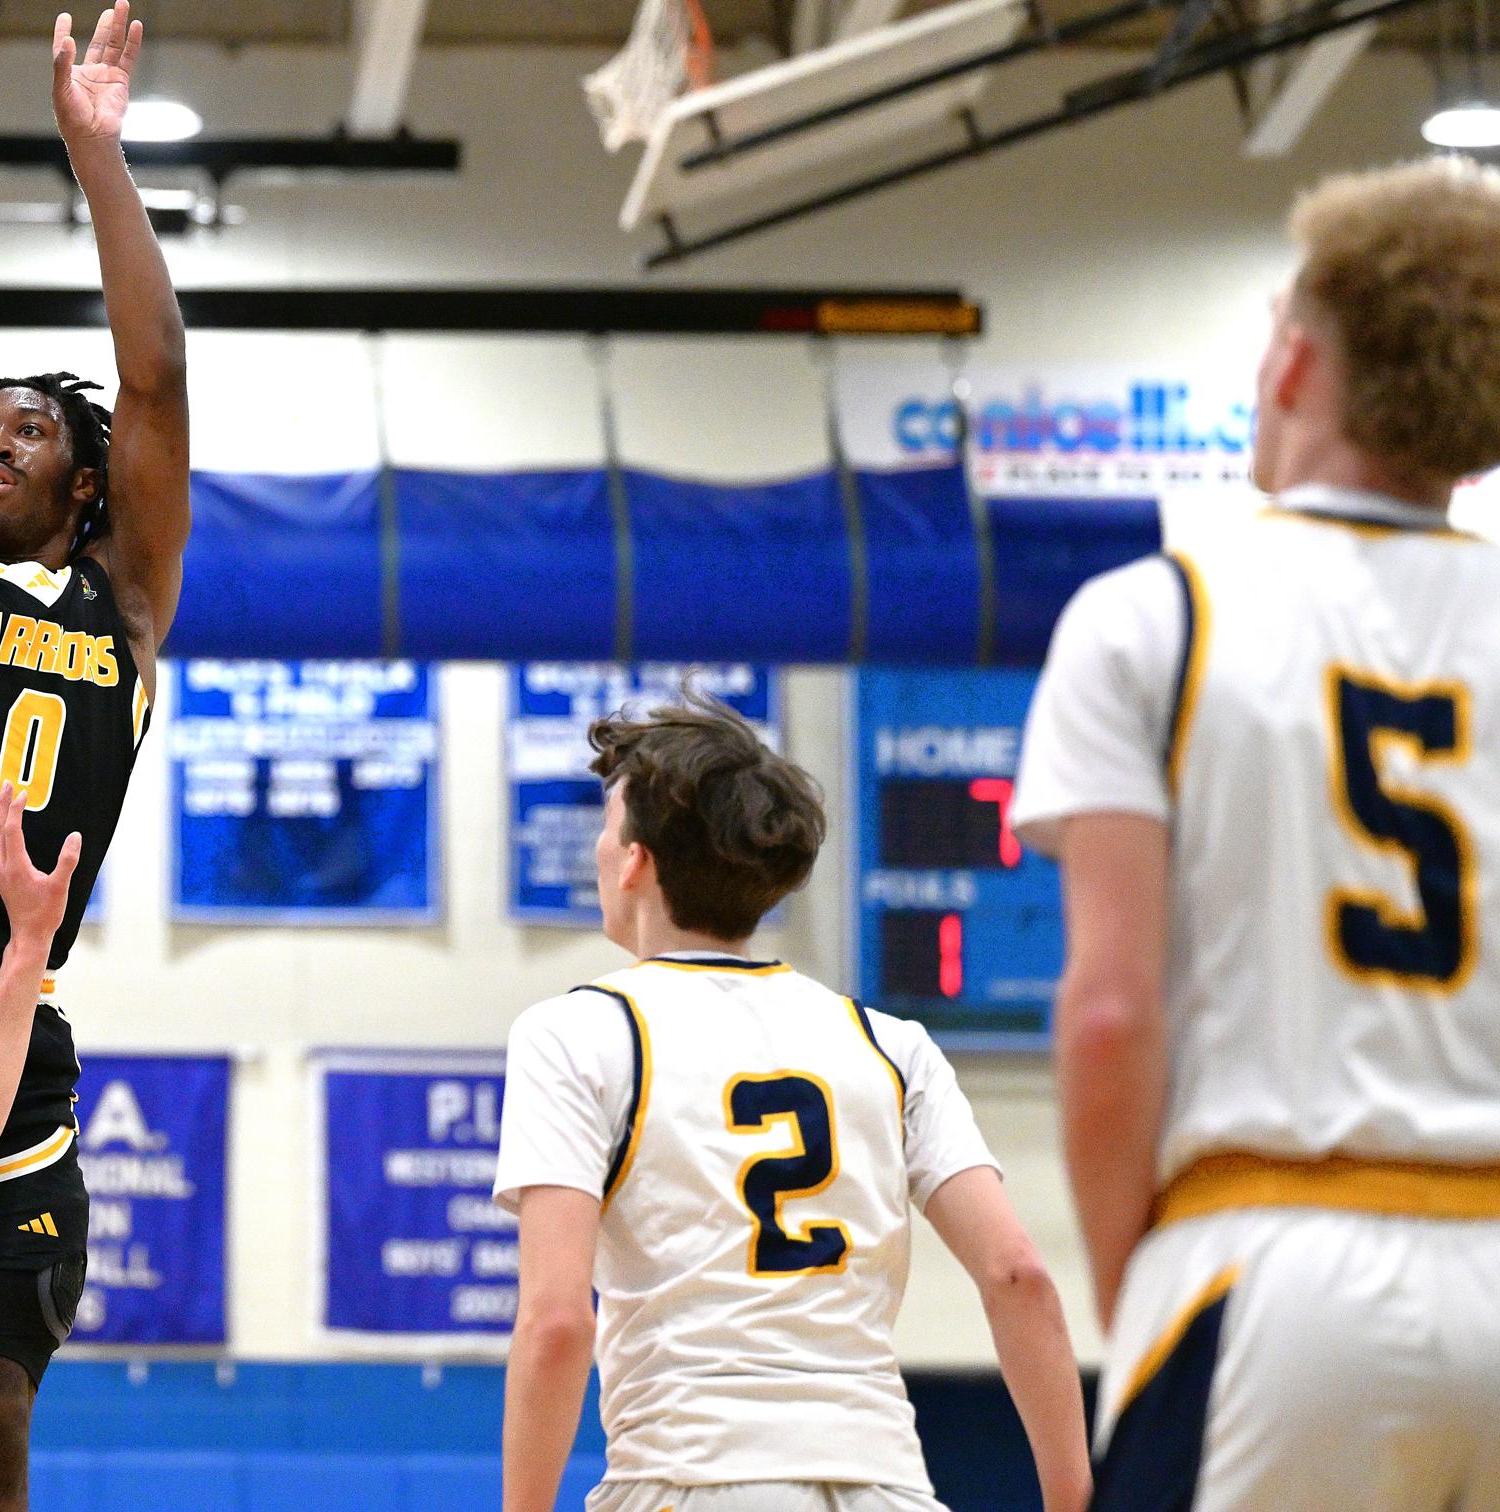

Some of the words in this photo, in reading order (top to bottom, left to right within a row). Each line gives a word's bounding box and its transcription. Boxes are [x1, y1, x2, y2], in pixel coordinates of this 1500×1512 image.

[875, 726, 1019, 776] HOME
[863, 868, 975, 908] FOULS
[1324, 658, 1480, 996] 5
[721, 1067, 853, 1279] 2
